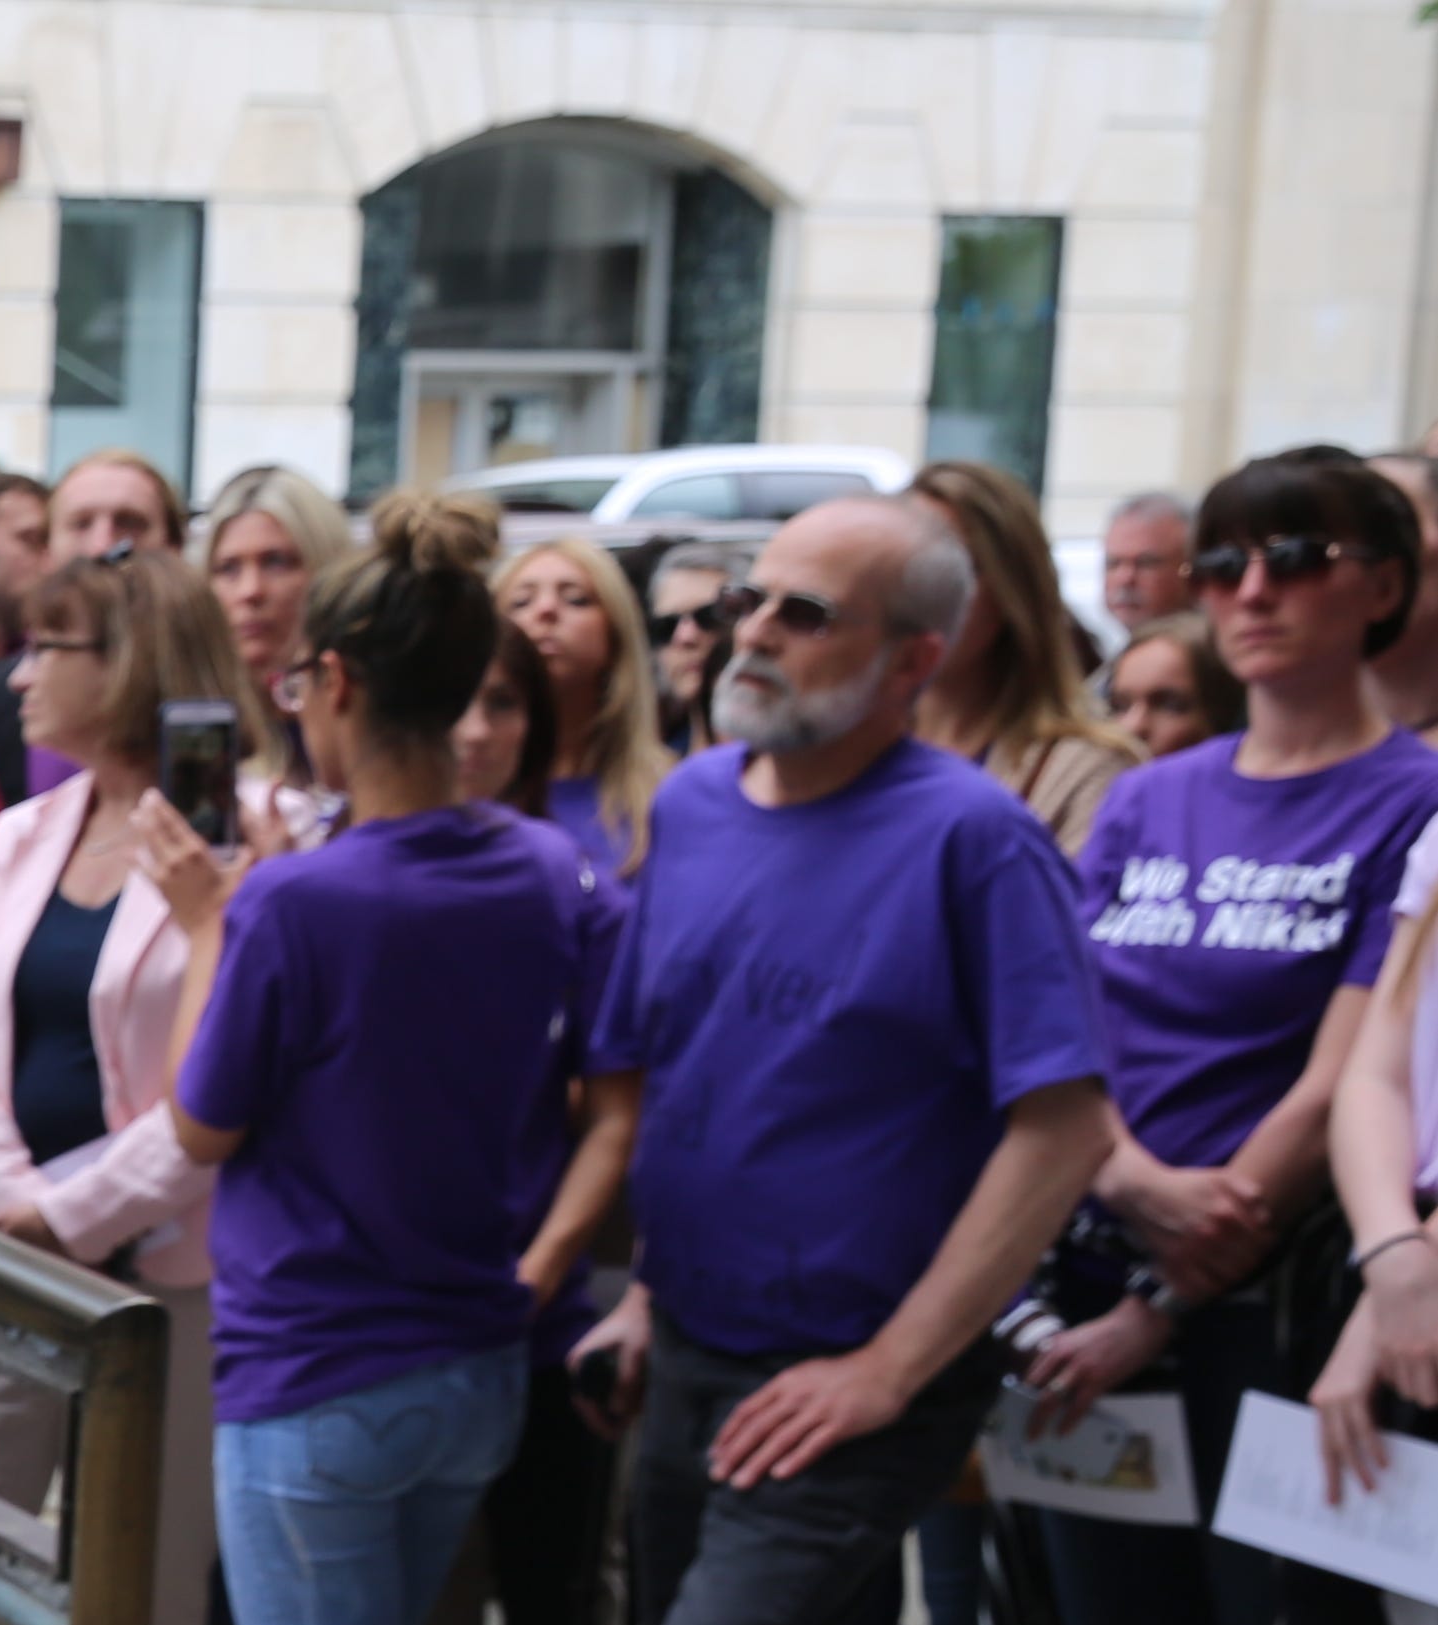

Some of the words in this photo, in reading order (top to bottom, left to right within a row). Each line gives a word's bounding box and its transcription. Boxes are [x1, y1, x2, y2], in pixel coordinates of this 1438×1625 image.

[1119, 854, 1190, 902] We
[1195, 853, 1357, 903] Stand
[1088, 898, 1198, 947] With
